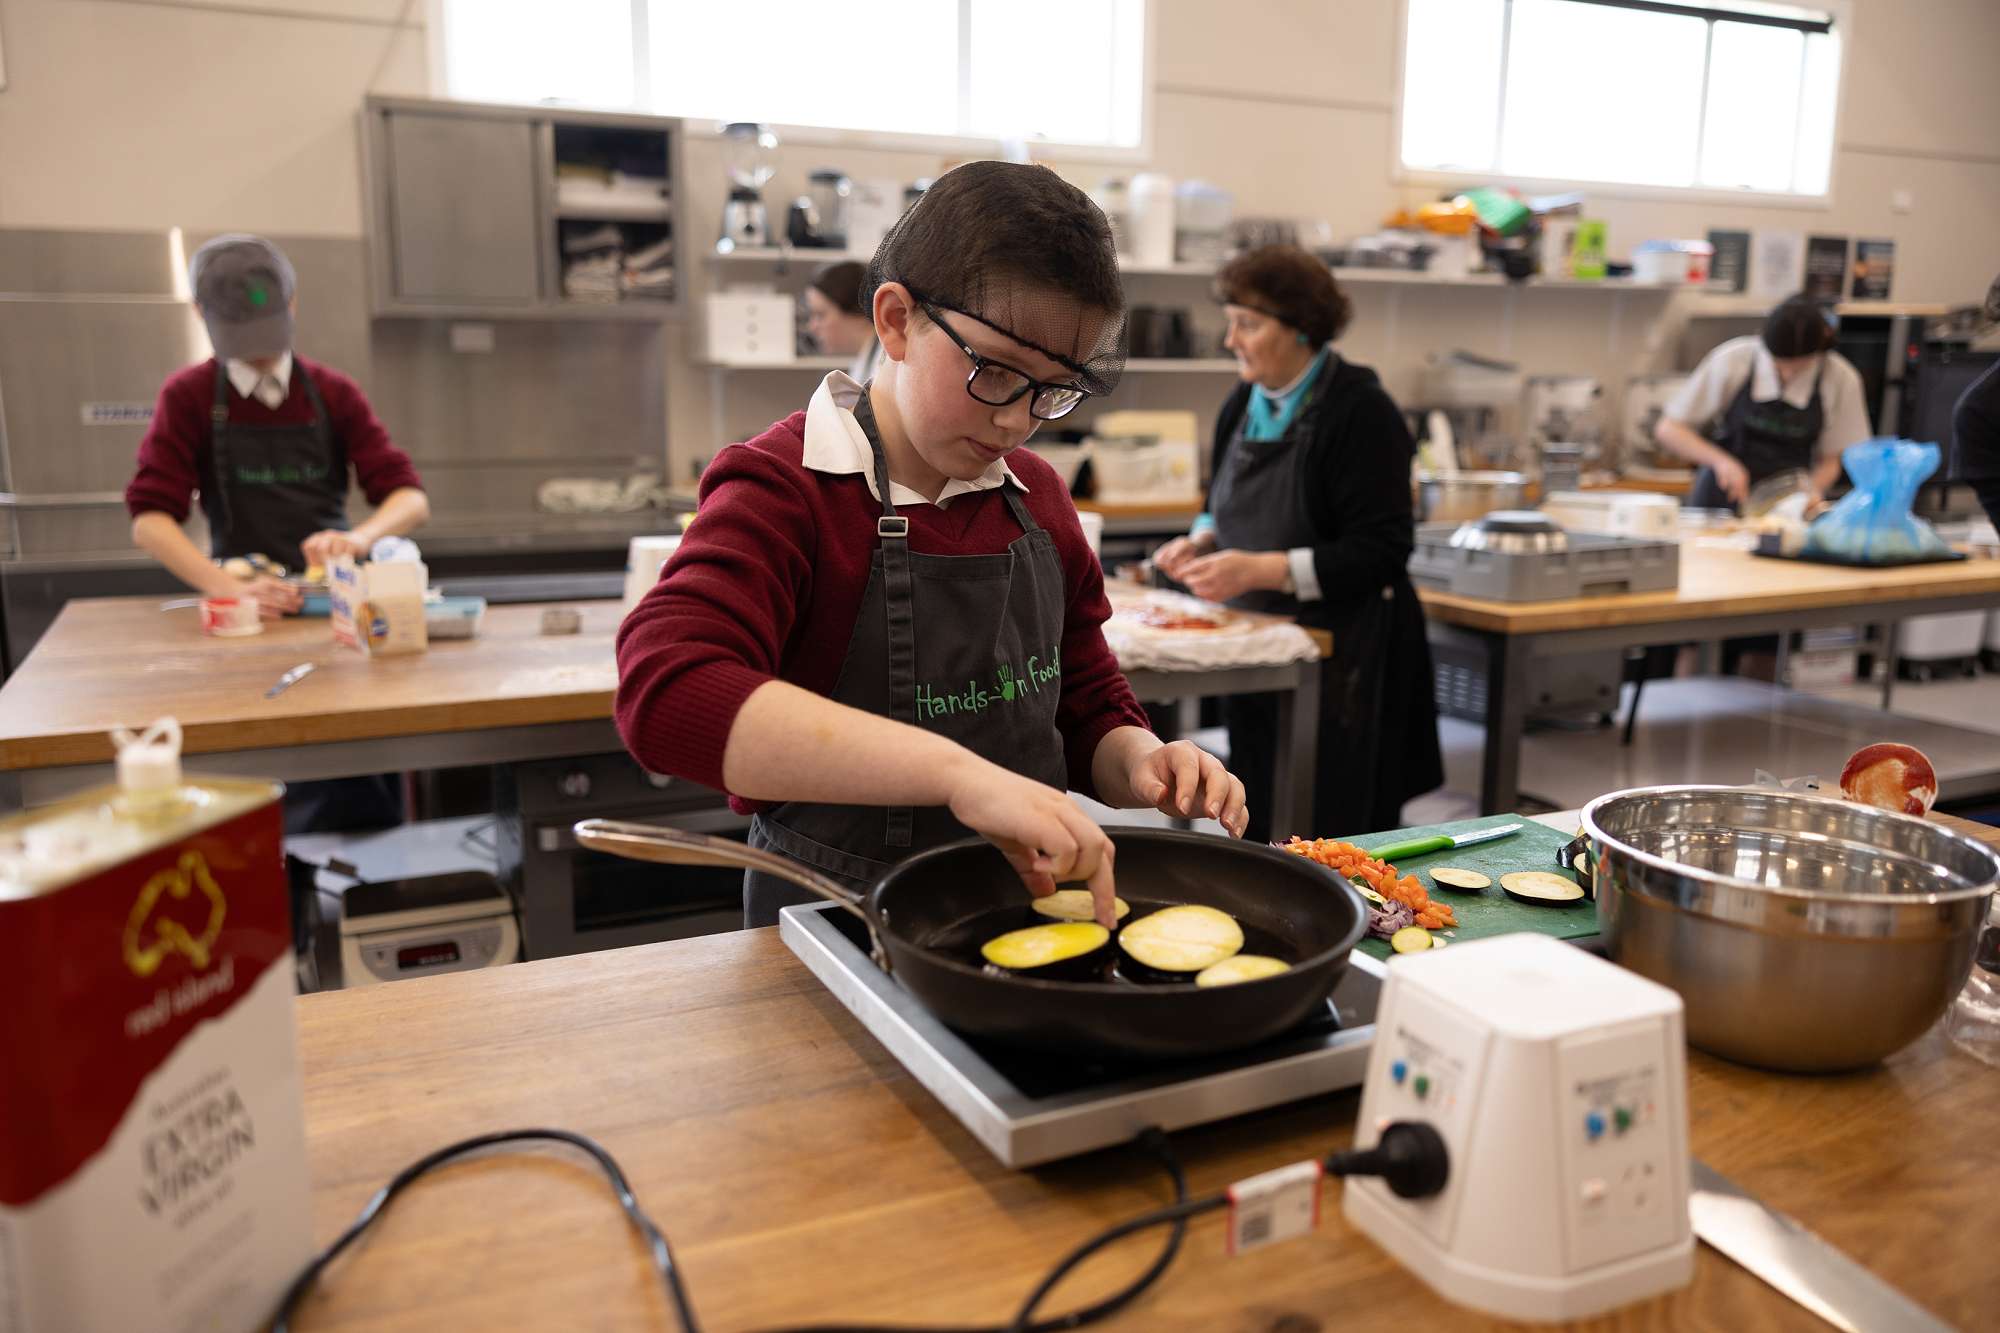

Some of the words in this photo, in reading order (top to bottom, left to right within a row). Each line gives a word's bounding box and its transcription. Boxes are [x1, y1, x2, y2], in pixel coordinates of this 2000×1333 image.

[1027, 645, 1061, 694] Food
[138, 1125, 255, 1217] VIRGIN
[141, 1087, 247, 1177] EXTRA
